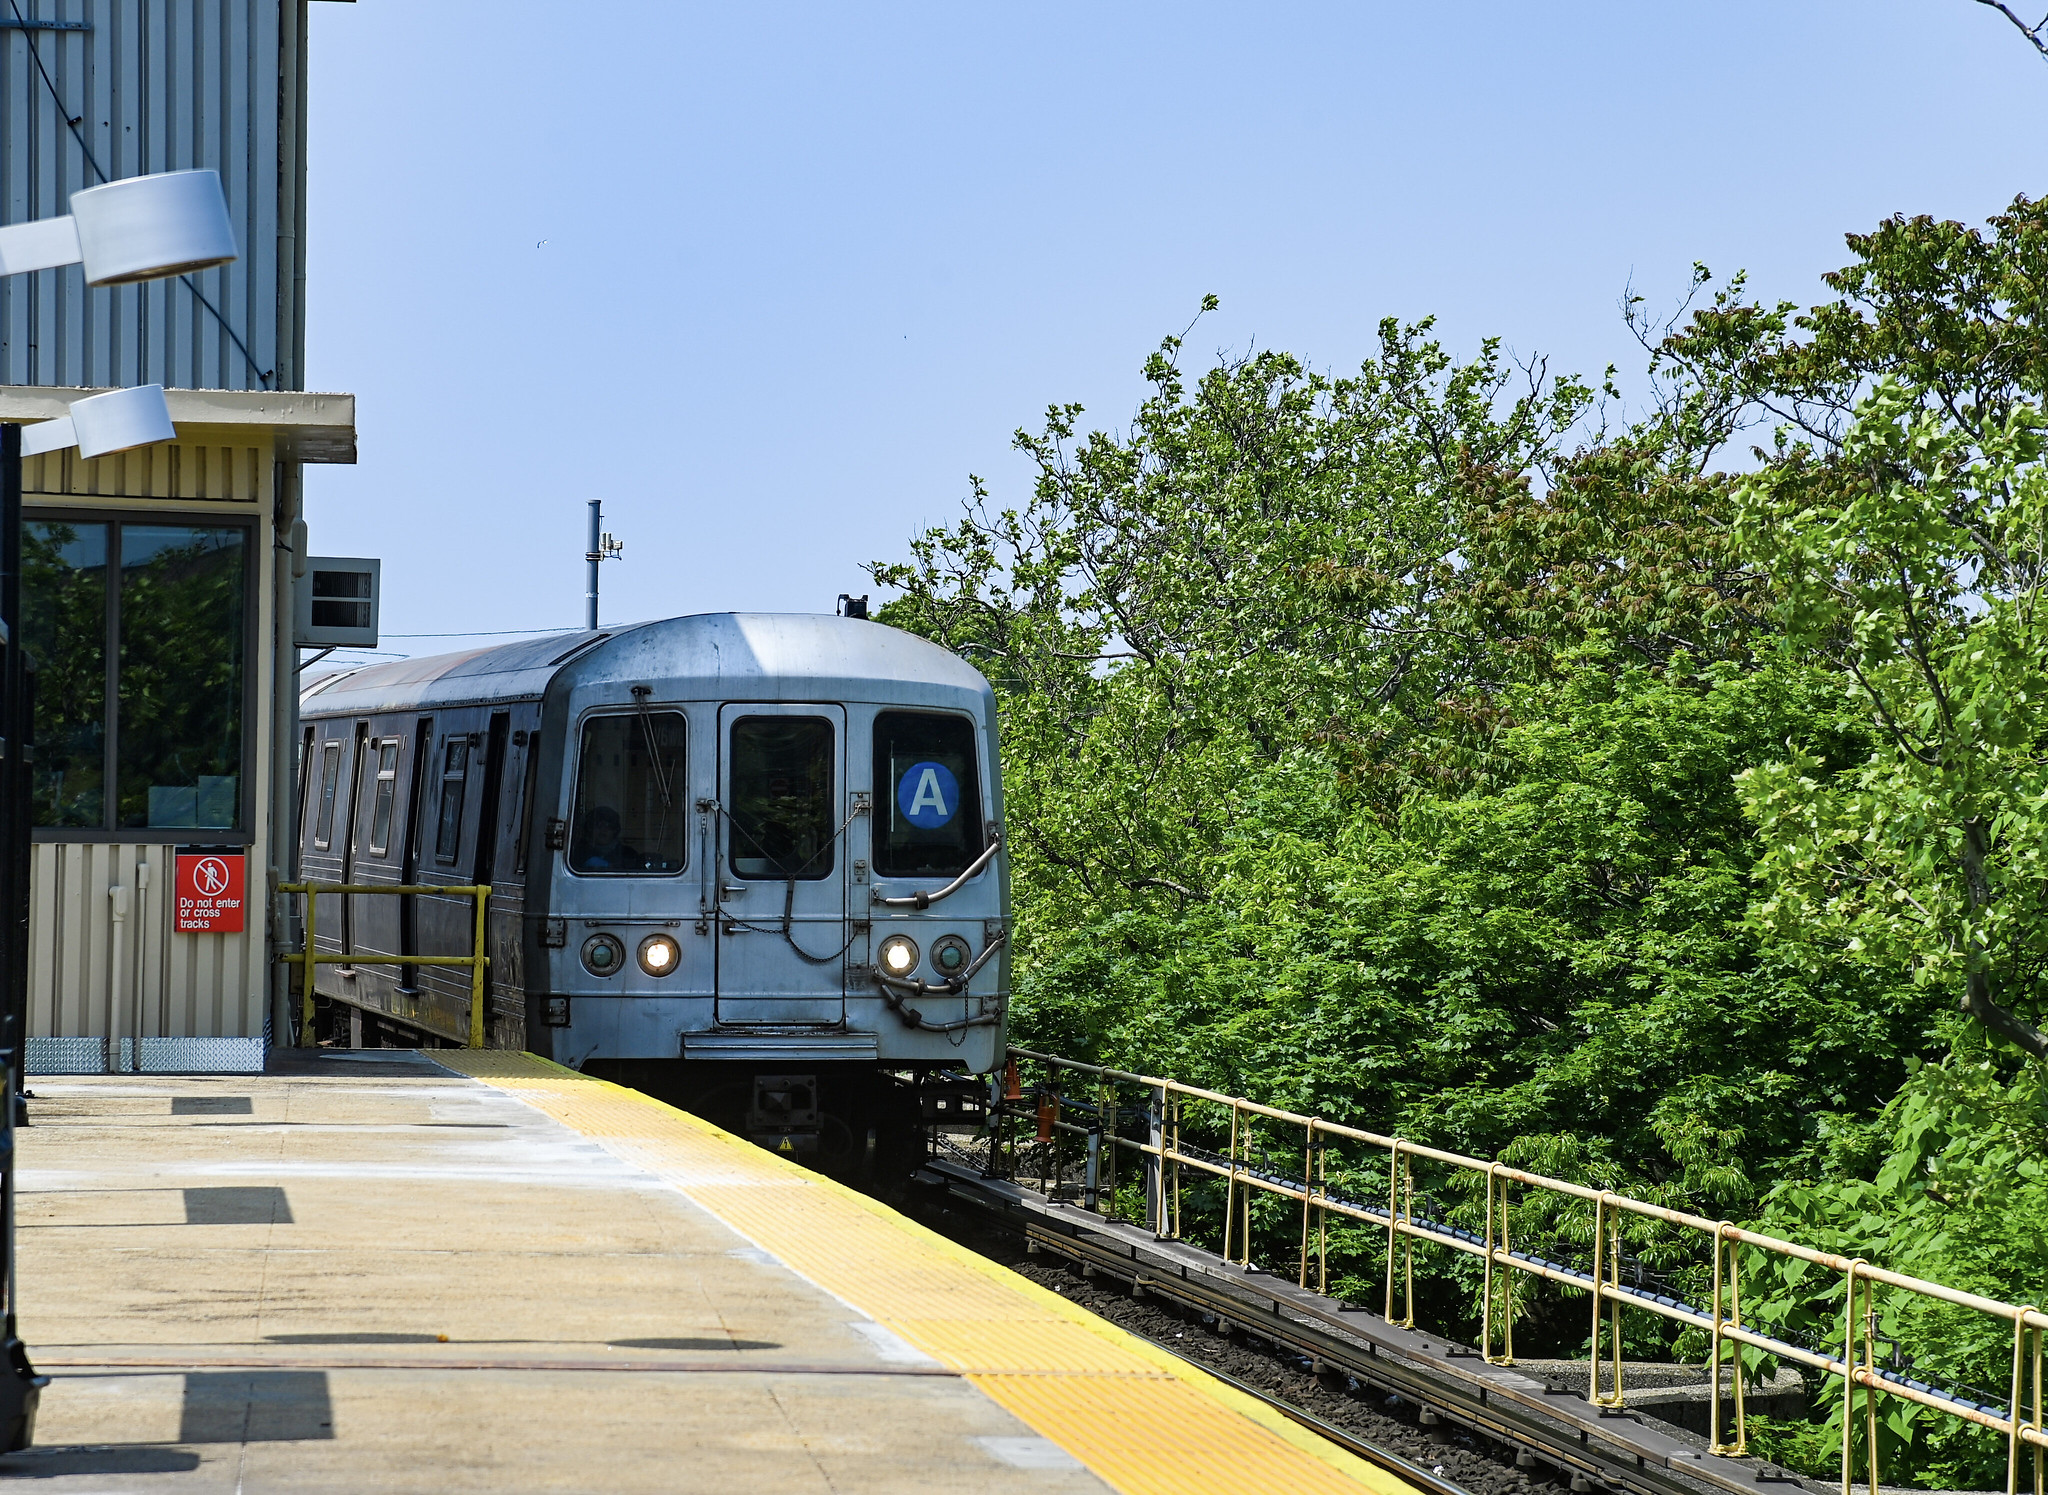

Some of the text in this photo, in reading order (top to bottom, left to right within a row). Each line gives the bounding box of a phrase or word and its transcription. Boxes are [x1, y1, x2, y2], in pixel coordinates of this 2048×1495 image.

[909, 768, 948, 816] A
[180, 897, 240, 908] Do not enter
[180, 908, 221, 917] or cross
[180, 918, 210, 928] tracks
